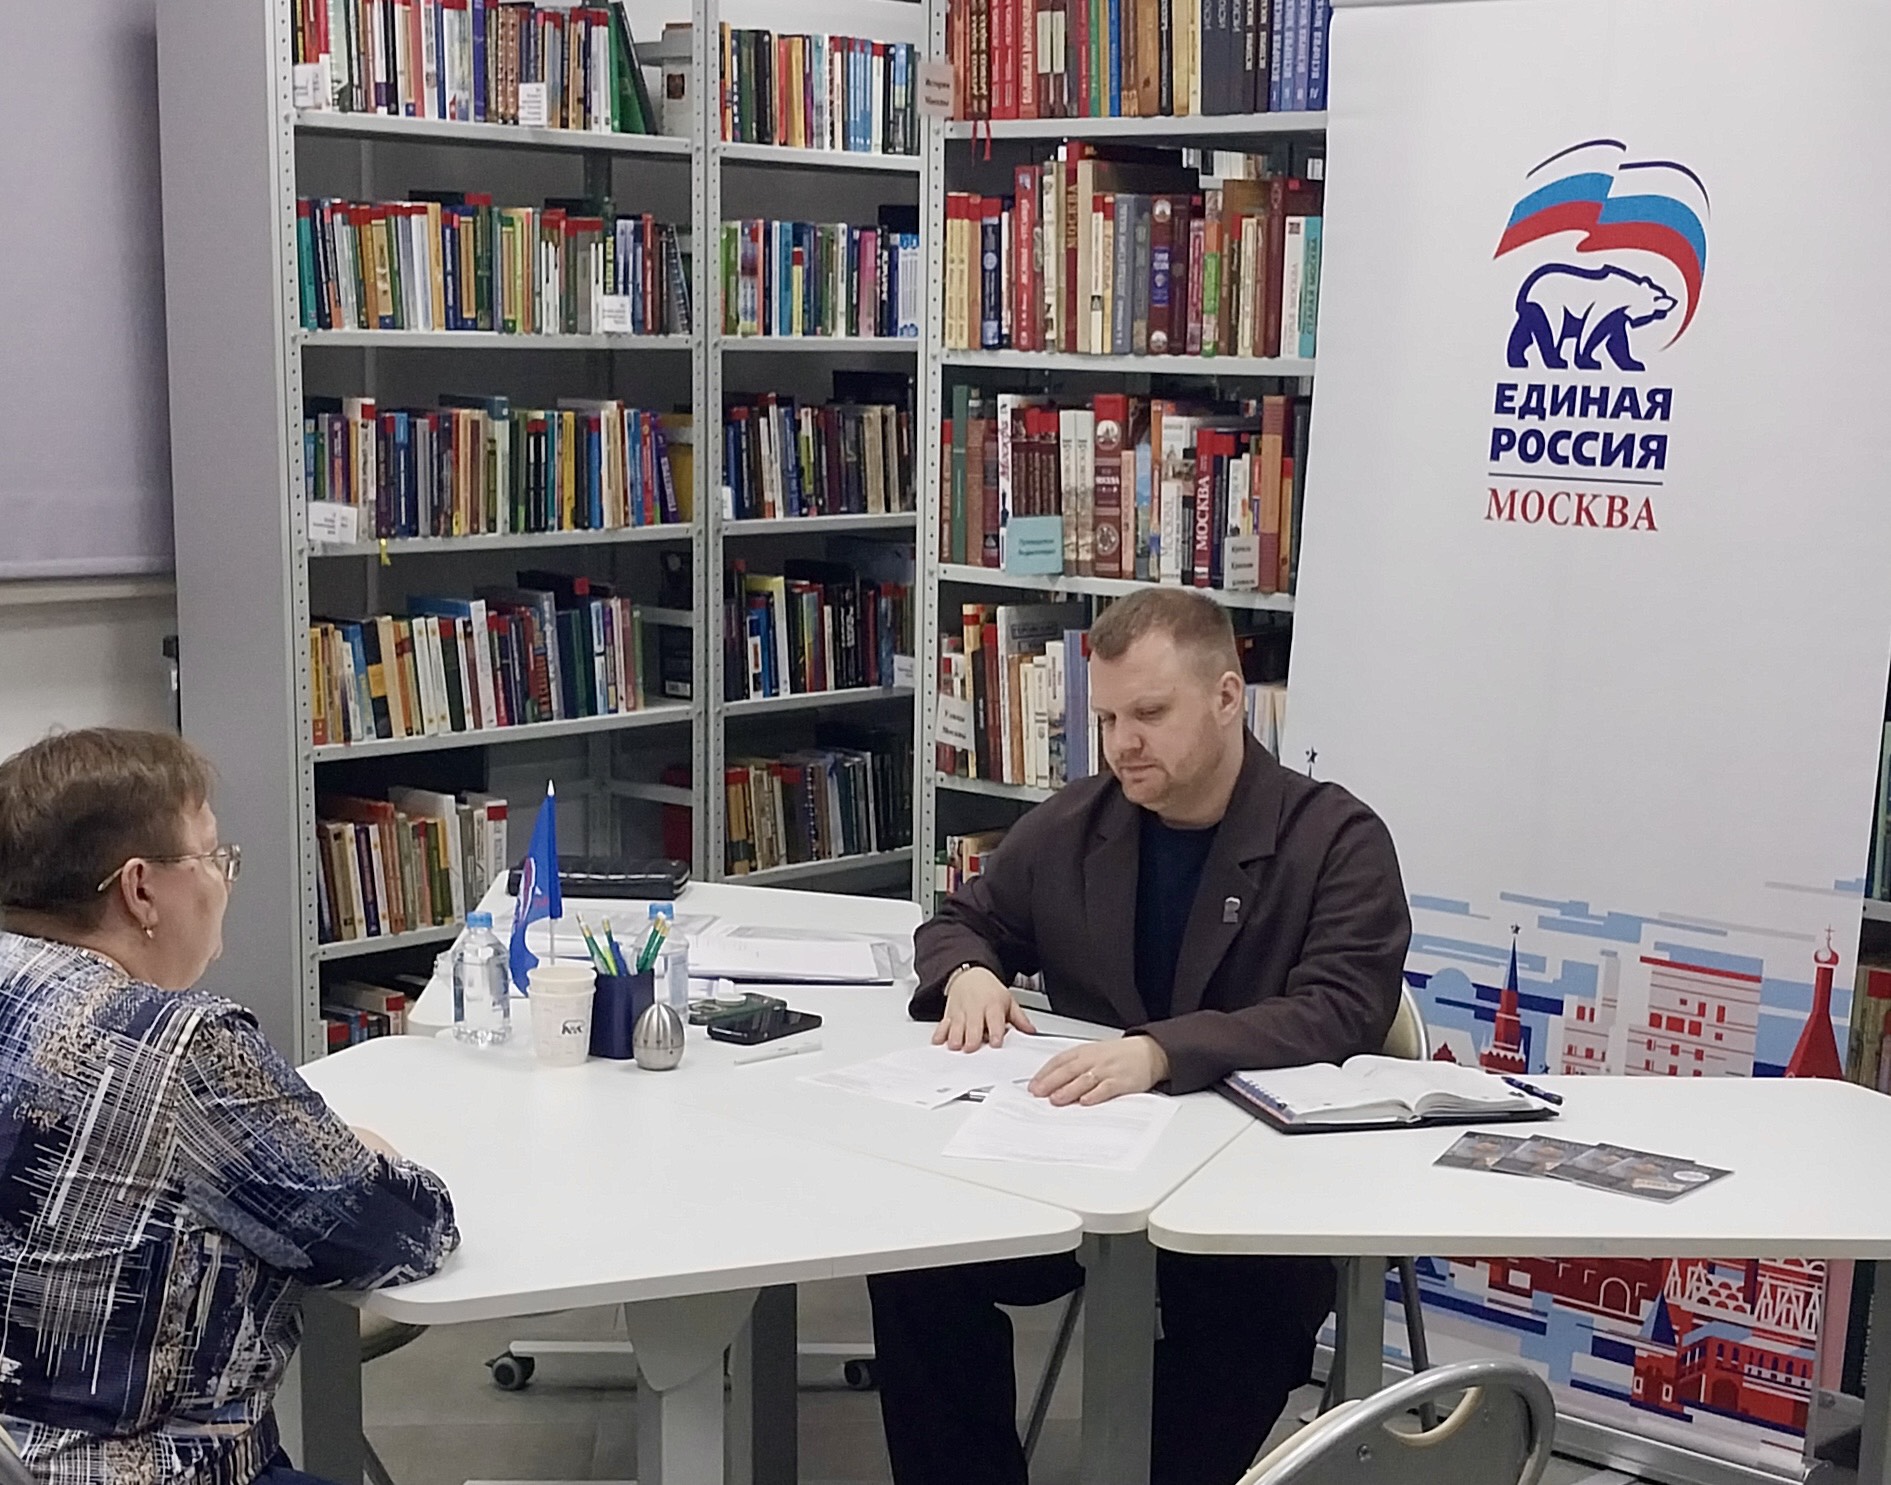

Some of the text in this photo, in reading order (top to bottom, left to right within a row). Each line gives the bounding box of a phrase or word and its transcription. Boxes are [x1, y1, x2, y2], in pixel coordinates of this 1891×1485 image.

[1067, 184, 1077, 248] МОСКВА
[1306, 290, 1315, 335] СТАРАЯ
[1494, 383, 1673, 422] ЕДИНАЯ
[1490, 427, 1668, 470] РОССИЯ
[1196, 475, 1210, 550] МОСКВА
[1484, 488, 1658, 531] МОСКВА
